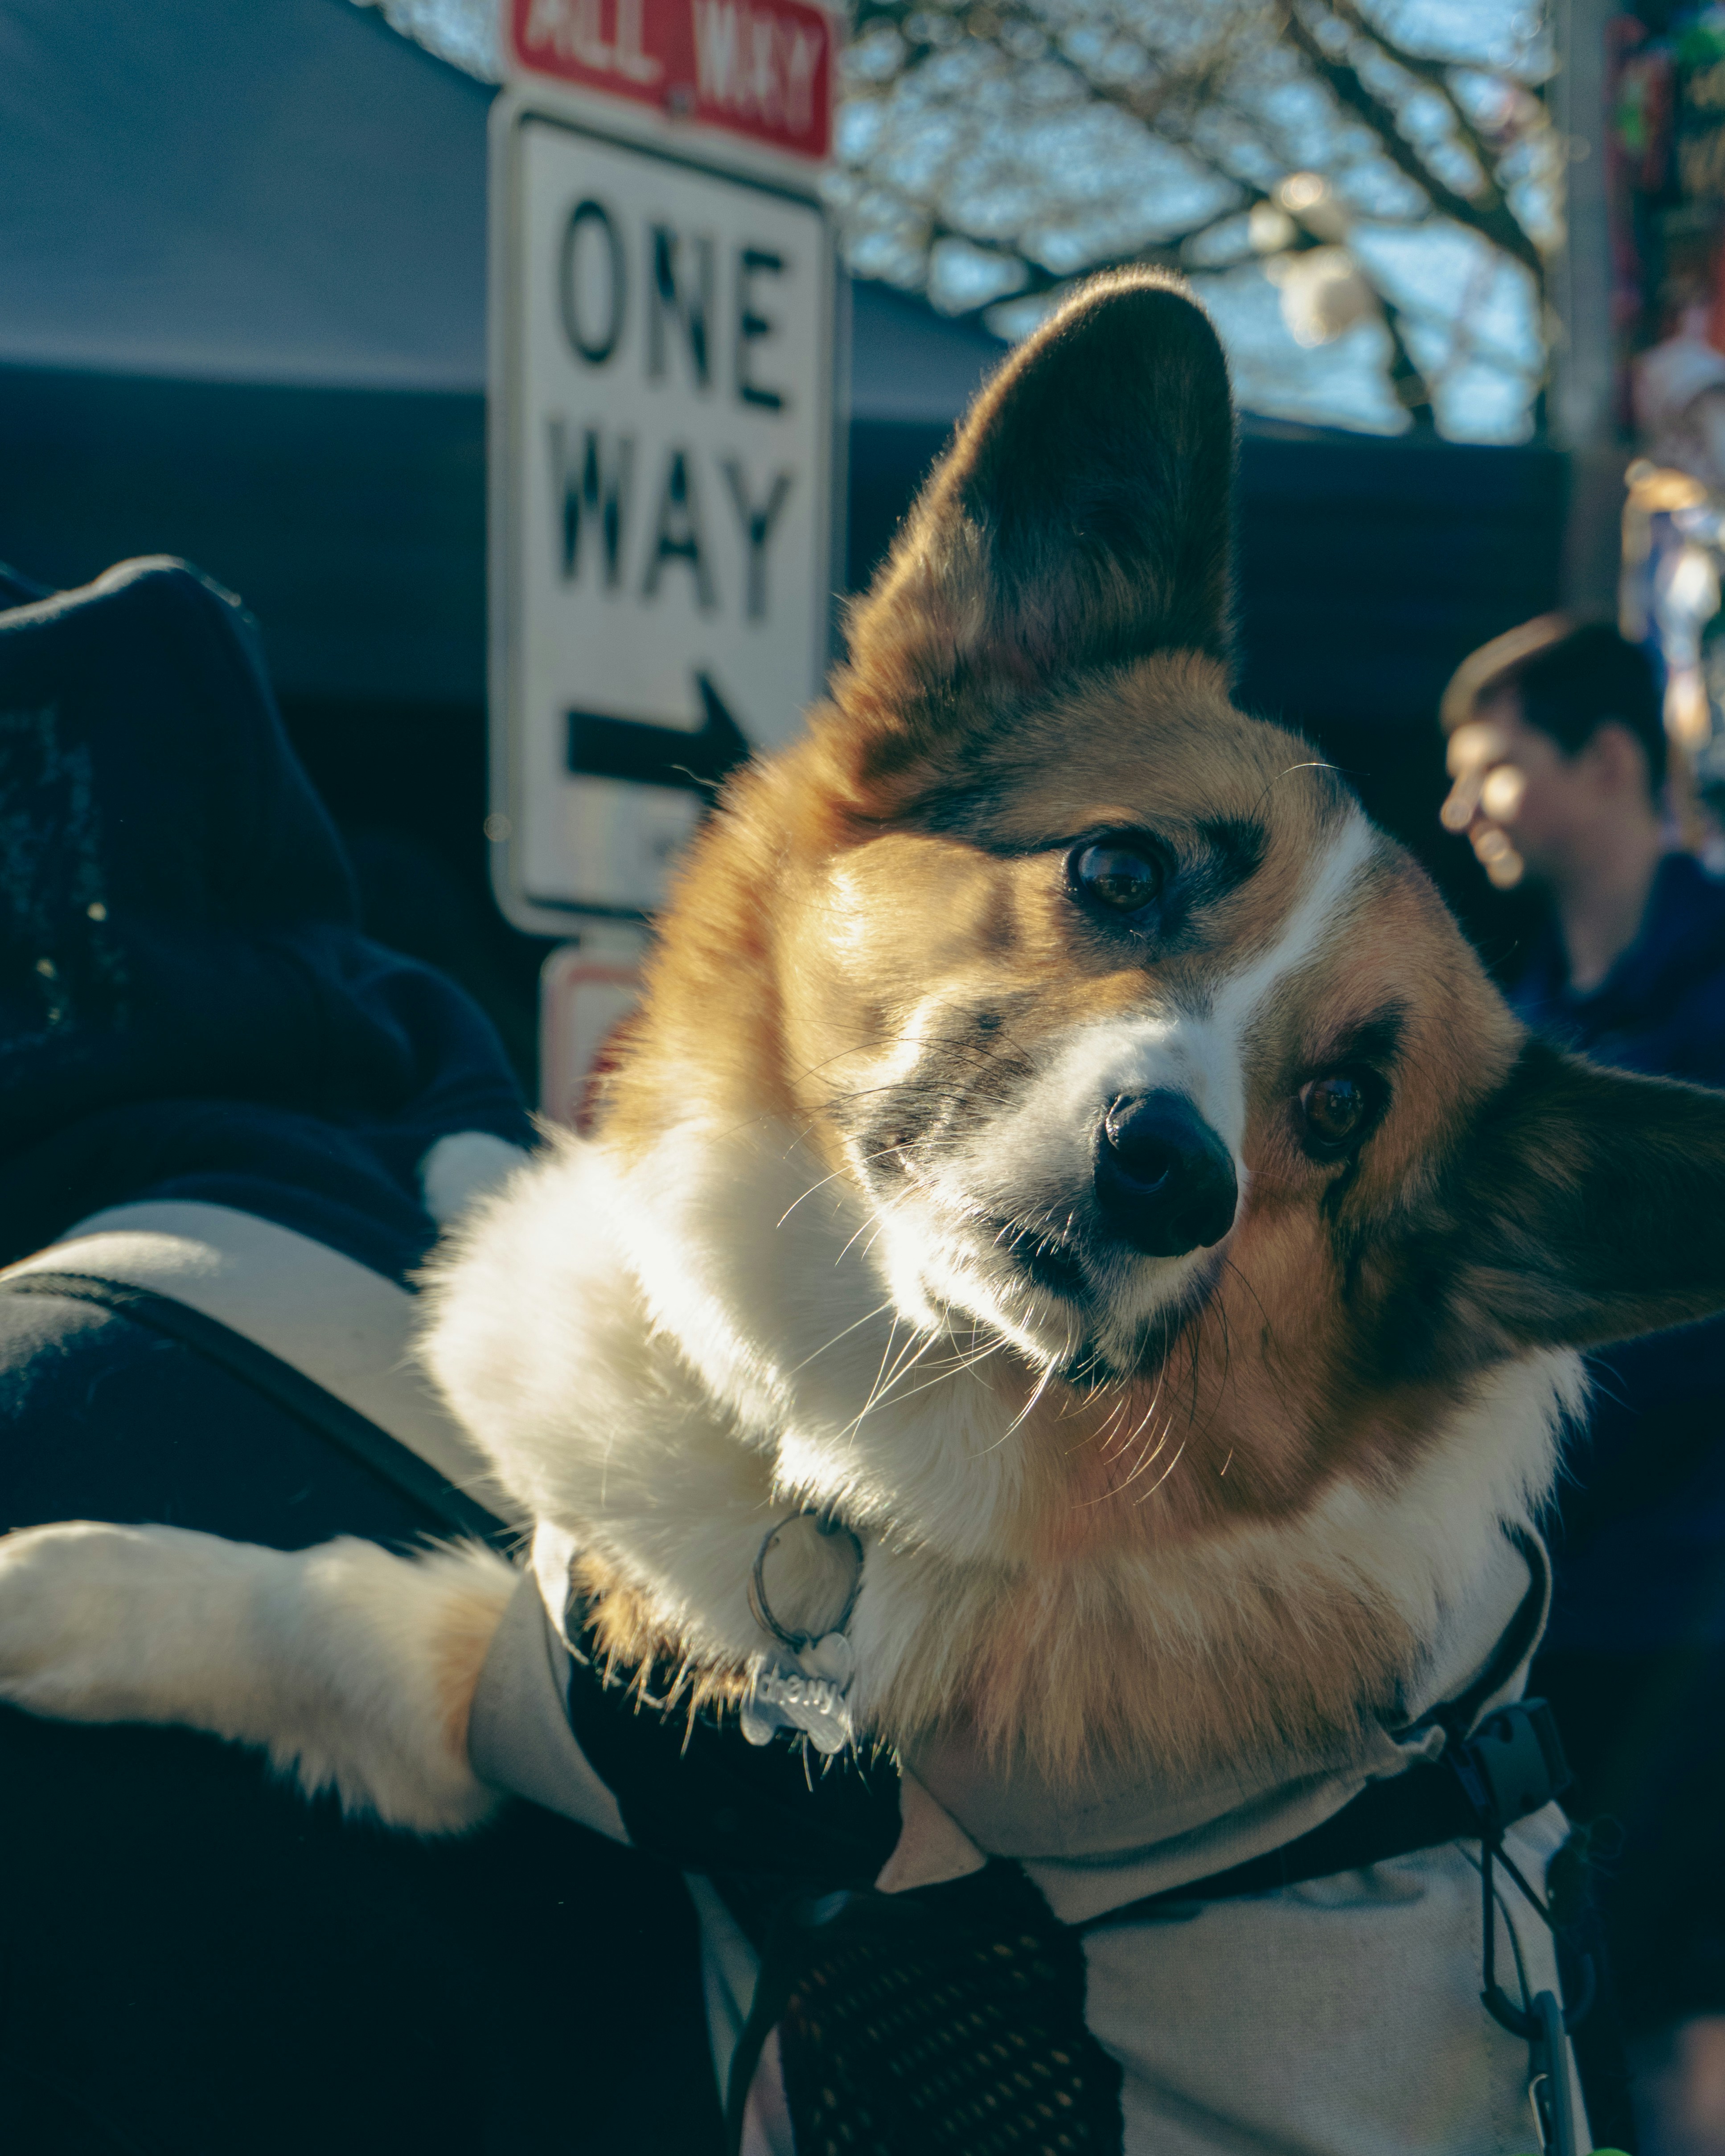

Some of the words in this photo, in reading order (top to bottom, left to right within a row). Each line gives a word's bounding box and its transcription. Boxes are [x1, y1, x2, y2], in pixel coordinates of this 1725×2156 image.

[694, 0, 822, 135] WAY
[557, 197, 785, 411] ONE
[546, 417, 792, 620] WAY
